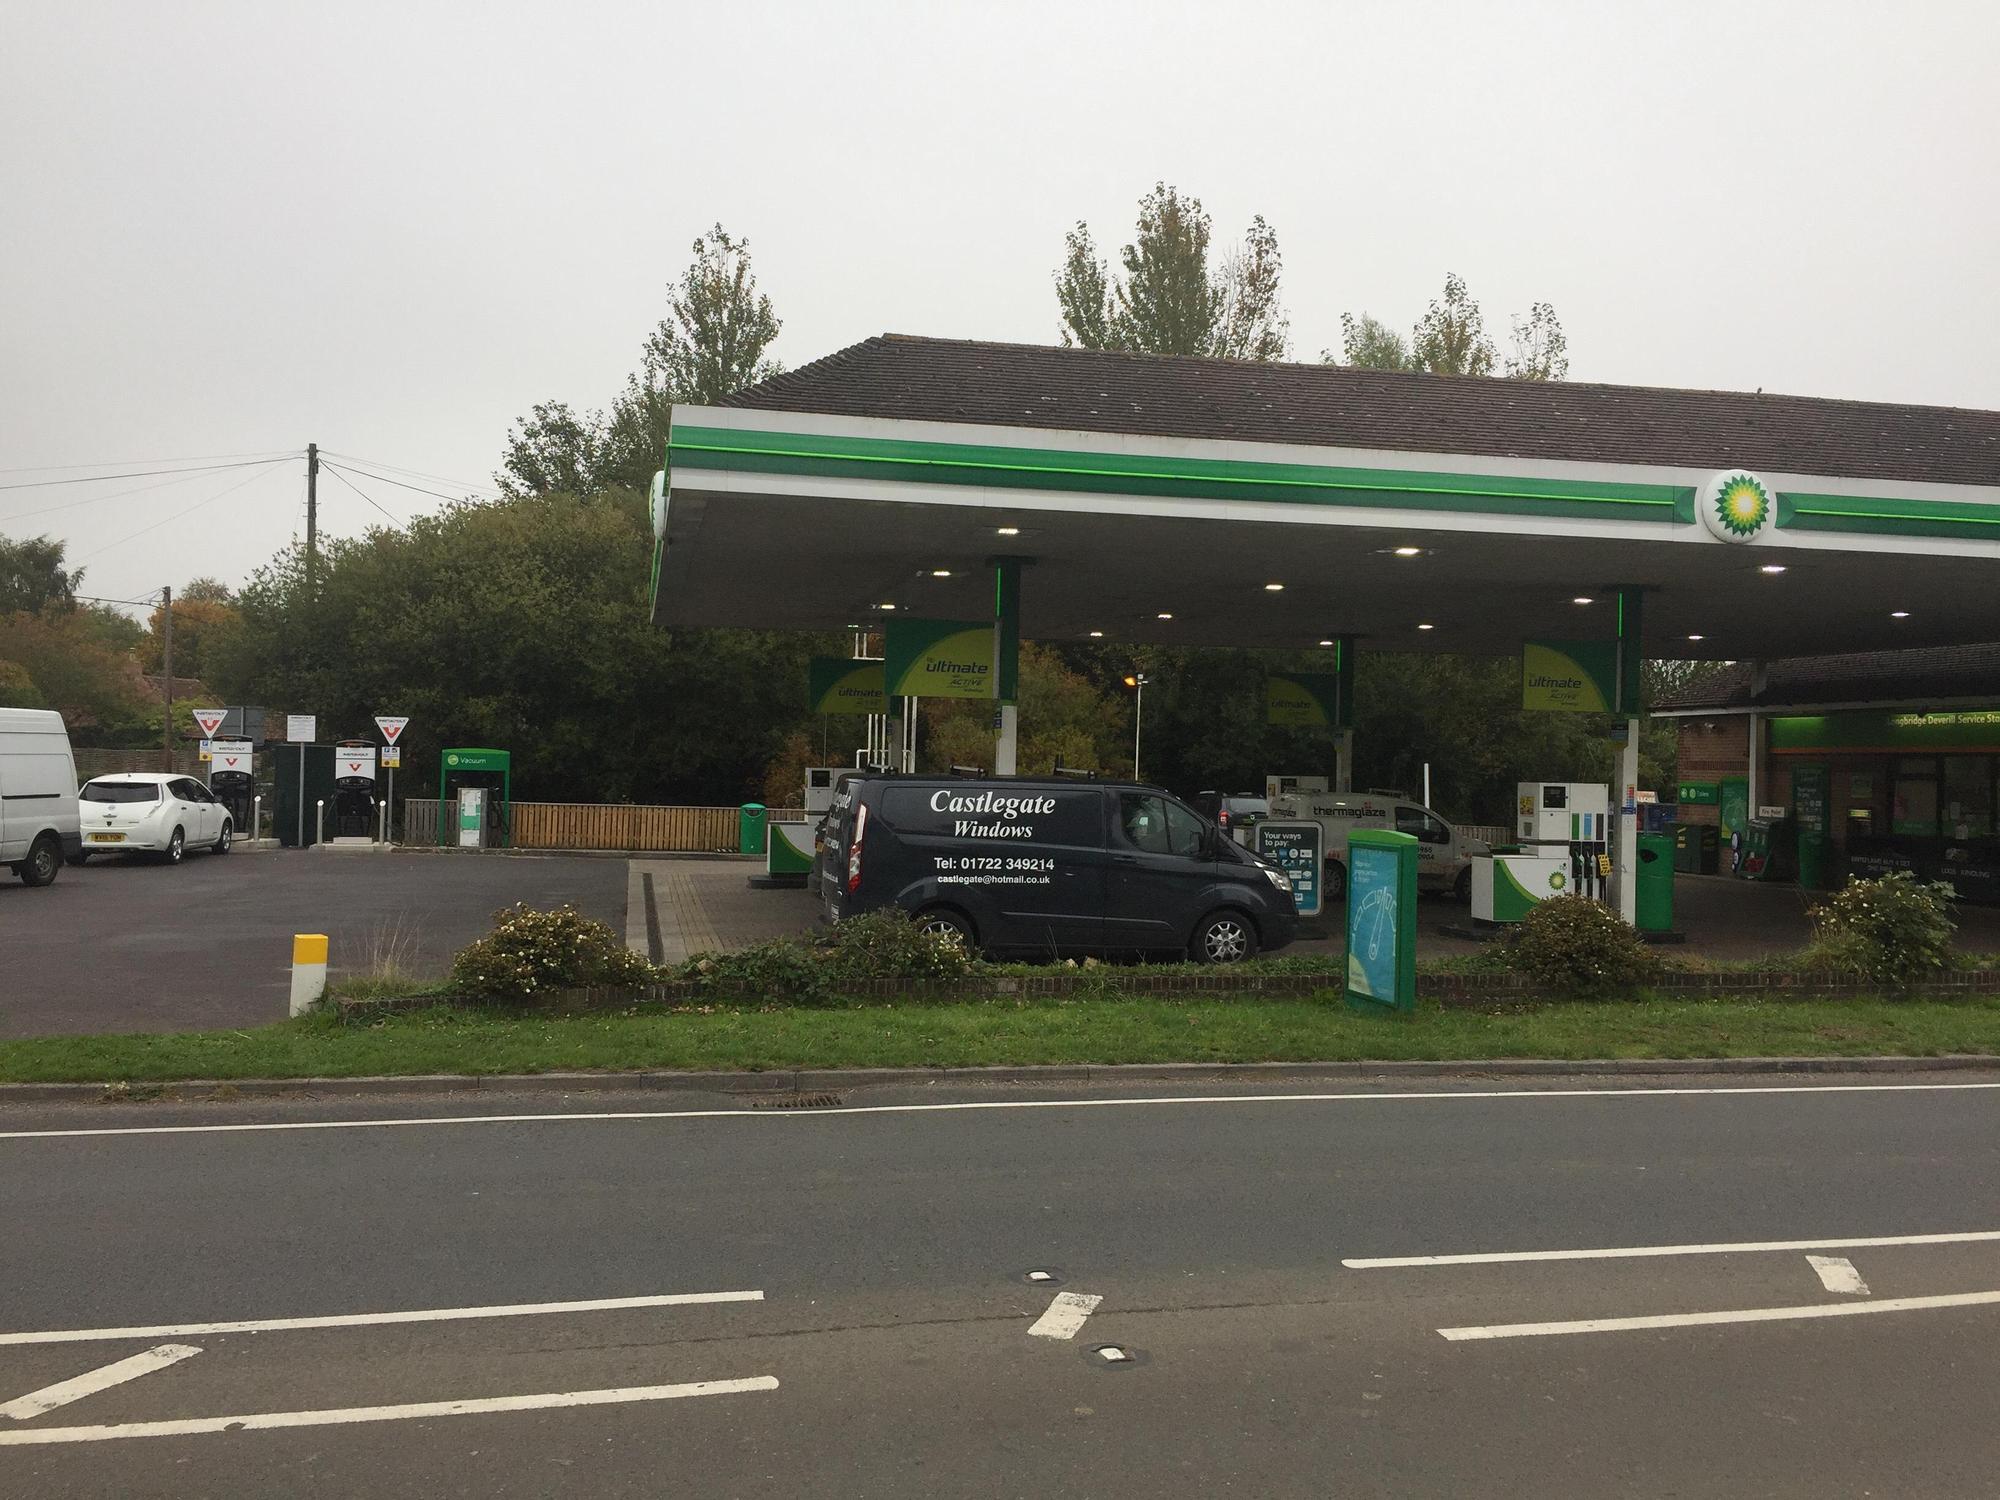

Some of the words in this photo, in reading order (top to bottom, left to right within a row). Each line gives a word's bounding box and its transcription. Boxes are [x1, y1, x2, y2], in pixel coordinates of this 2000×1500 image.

[926, 660, 988, 674] ultimate
[1528, 676, 1582, 689] ultimate
[838, 687, 882, 698] ultimate
[1928, 715, 1956, 725] Deverill
[1958, 714, 1985, 724] Service
[930, 790, 1056, 819] Castlegate
[1313, 806, 1386, 818] thermaglaze
[953, 820, 1033, 838] Windows
[1263, 831, 1281, 840] Your
[1282, 833, 1302, 841] ways
[934, 857, 957, 870] Tel:
[960, 857, 1002, 870] 01722
[1005, 857, 1055, 871] 349214
[937, 875, 1051, 886] castlegate@hotmail.co.uk
